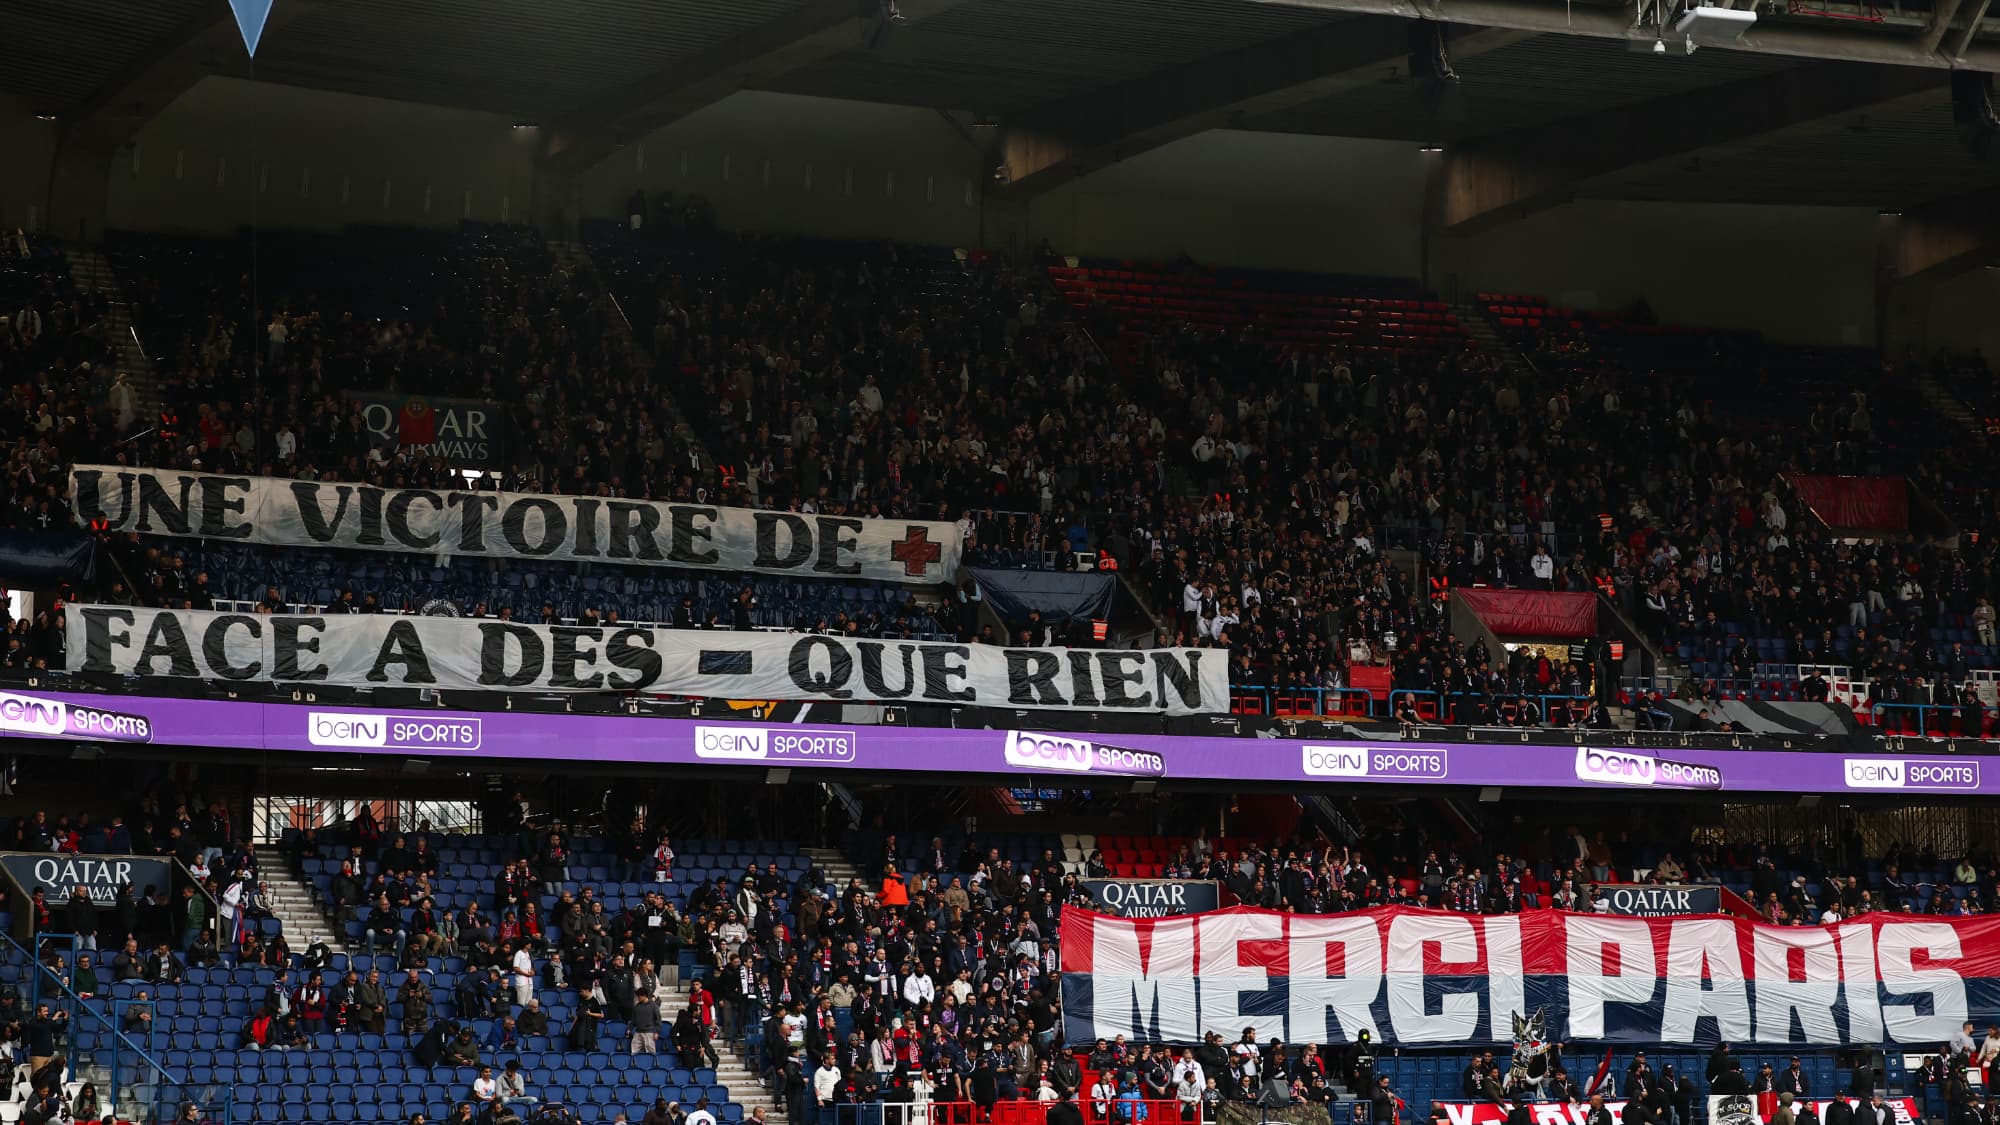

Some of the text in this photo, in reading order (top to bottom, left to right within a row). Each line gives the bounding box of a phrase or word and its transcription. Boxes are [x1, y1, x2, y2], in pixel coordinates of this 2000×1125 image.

[361, 404, 488, 440] QAR
[73, 470, 252, 538] UNE
[290, 482, 719, 564] VICTOIRE
[752, 513, 862, 574] DE
[80, 608, 329, 681] FACE
[366, 620, 436, 683] A
[476, 623, 662, 690] DES
[788, 635, 976, 702] QUE
[1003, 649, 1201, 708] RIEN
[0, 699, 148, 737] eIN SPORTS
[317, 715, 473, 743] beIN SPORTS
[703, 729, 848, 755] beIN SPORTS
[1016, 732, 1163, 771] beIN SPORTS
[1310, 748, 1441, 772] beIN SPORTS
[1586, 748, 1720, 784] beIN SPORTS
[1851, 761, 1973, 783] beIN SPORTS
[35, 859, 131, 887] QATAR
[1103, 884, 1186, 909] QATAR
[1613, 890, 1691, 914] QATAR
[1092, 914, 1968, 1043] MERCI PARIS
